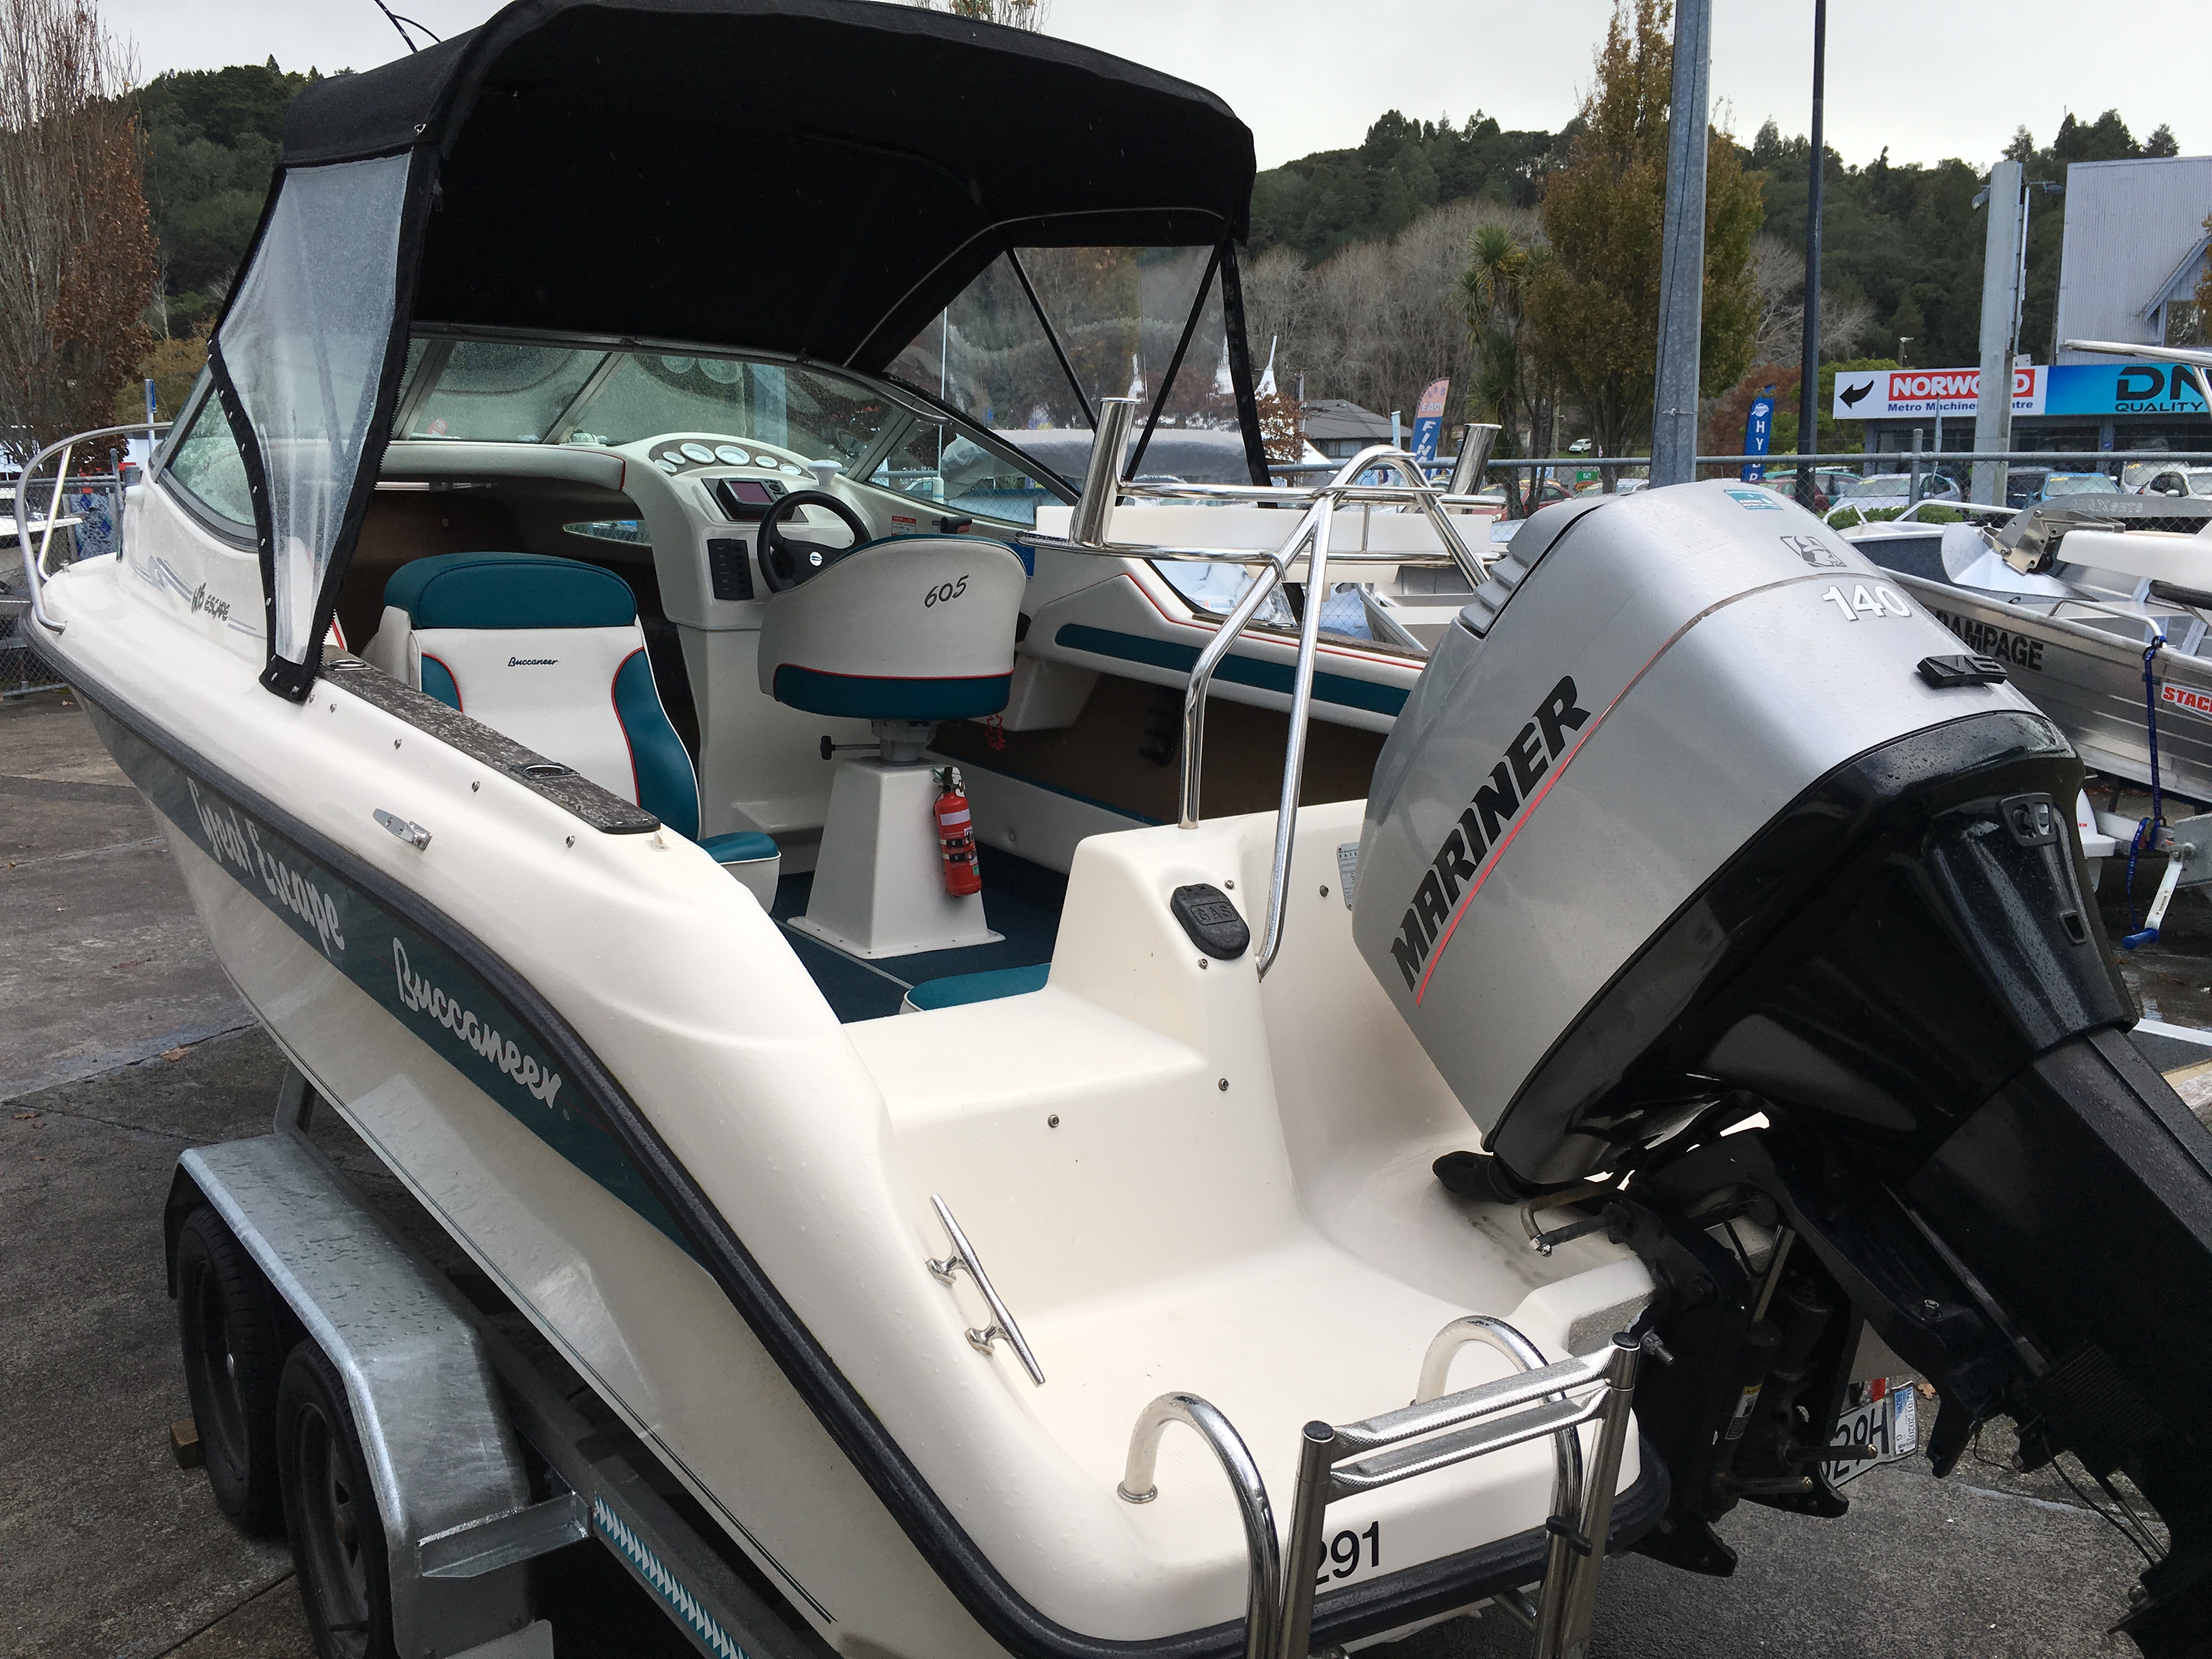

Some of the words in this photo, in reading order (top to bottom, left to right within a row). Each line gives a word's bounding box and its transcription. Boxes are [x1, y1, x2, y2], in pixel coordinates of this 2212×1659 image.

[1421, 403, 1444, 412] EASY
[1888, 403, 1922, 412] Metro
[2115, 402, 2204, 412] QUALITY
[924, 574, 969, 608] 605
[1821, 584, 1912, 622] 140
[507, 657, 558, 667] Buccaneer
[2163, 686, 2212, 713] STAC
[1390, 675, 1592, 992] MARINER
[187, 776, 255, 879] Great
[245, 818, 345, 957] Escape
[1197, 906, 1233, 921] GAS
[393, 937, 562, 1109] Buccaneer
[1906, 1389, 1915, 1437] 02/01/2020
